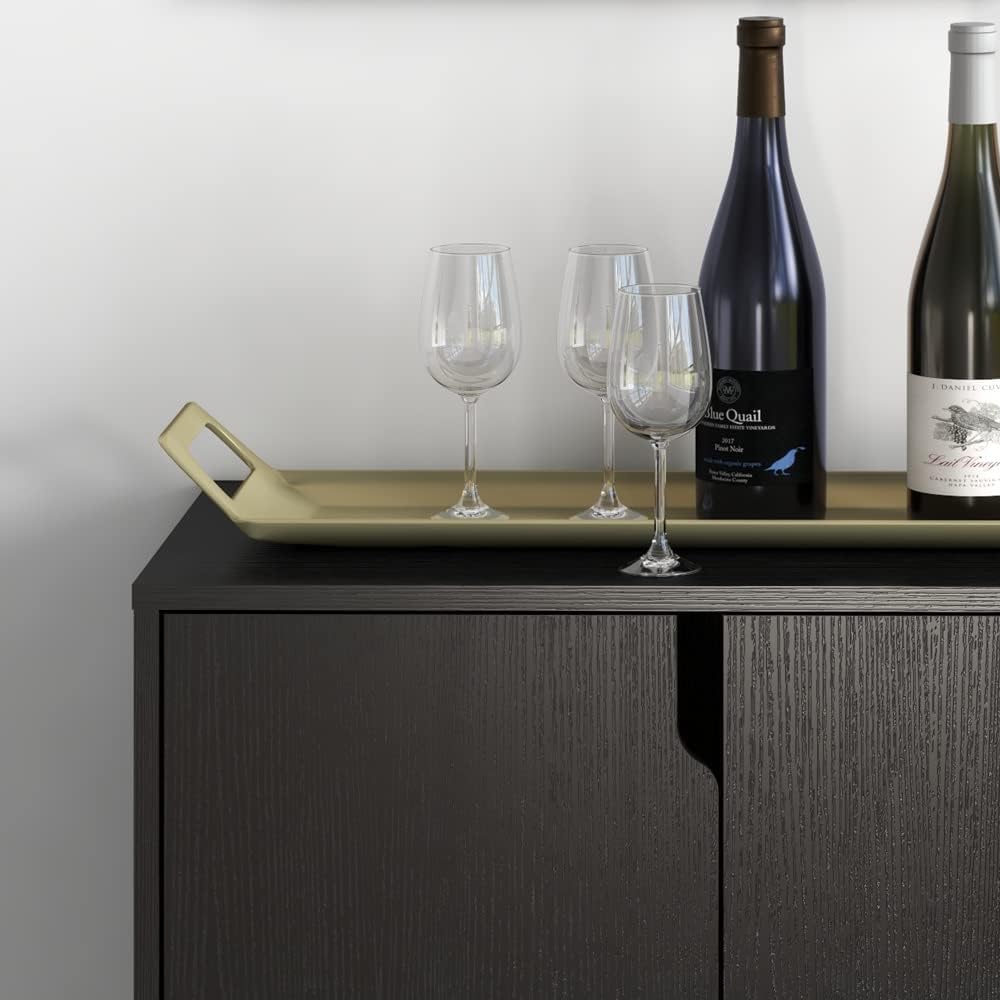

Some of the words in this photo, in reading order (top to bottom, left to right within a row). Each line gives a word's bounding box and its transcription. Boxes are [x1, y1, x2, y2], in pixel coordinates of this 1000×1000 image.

[726, 408, 762, 425] Quail
[714, 443, 729, 452] Pinot
[730, 445, 744, 453] Noir
